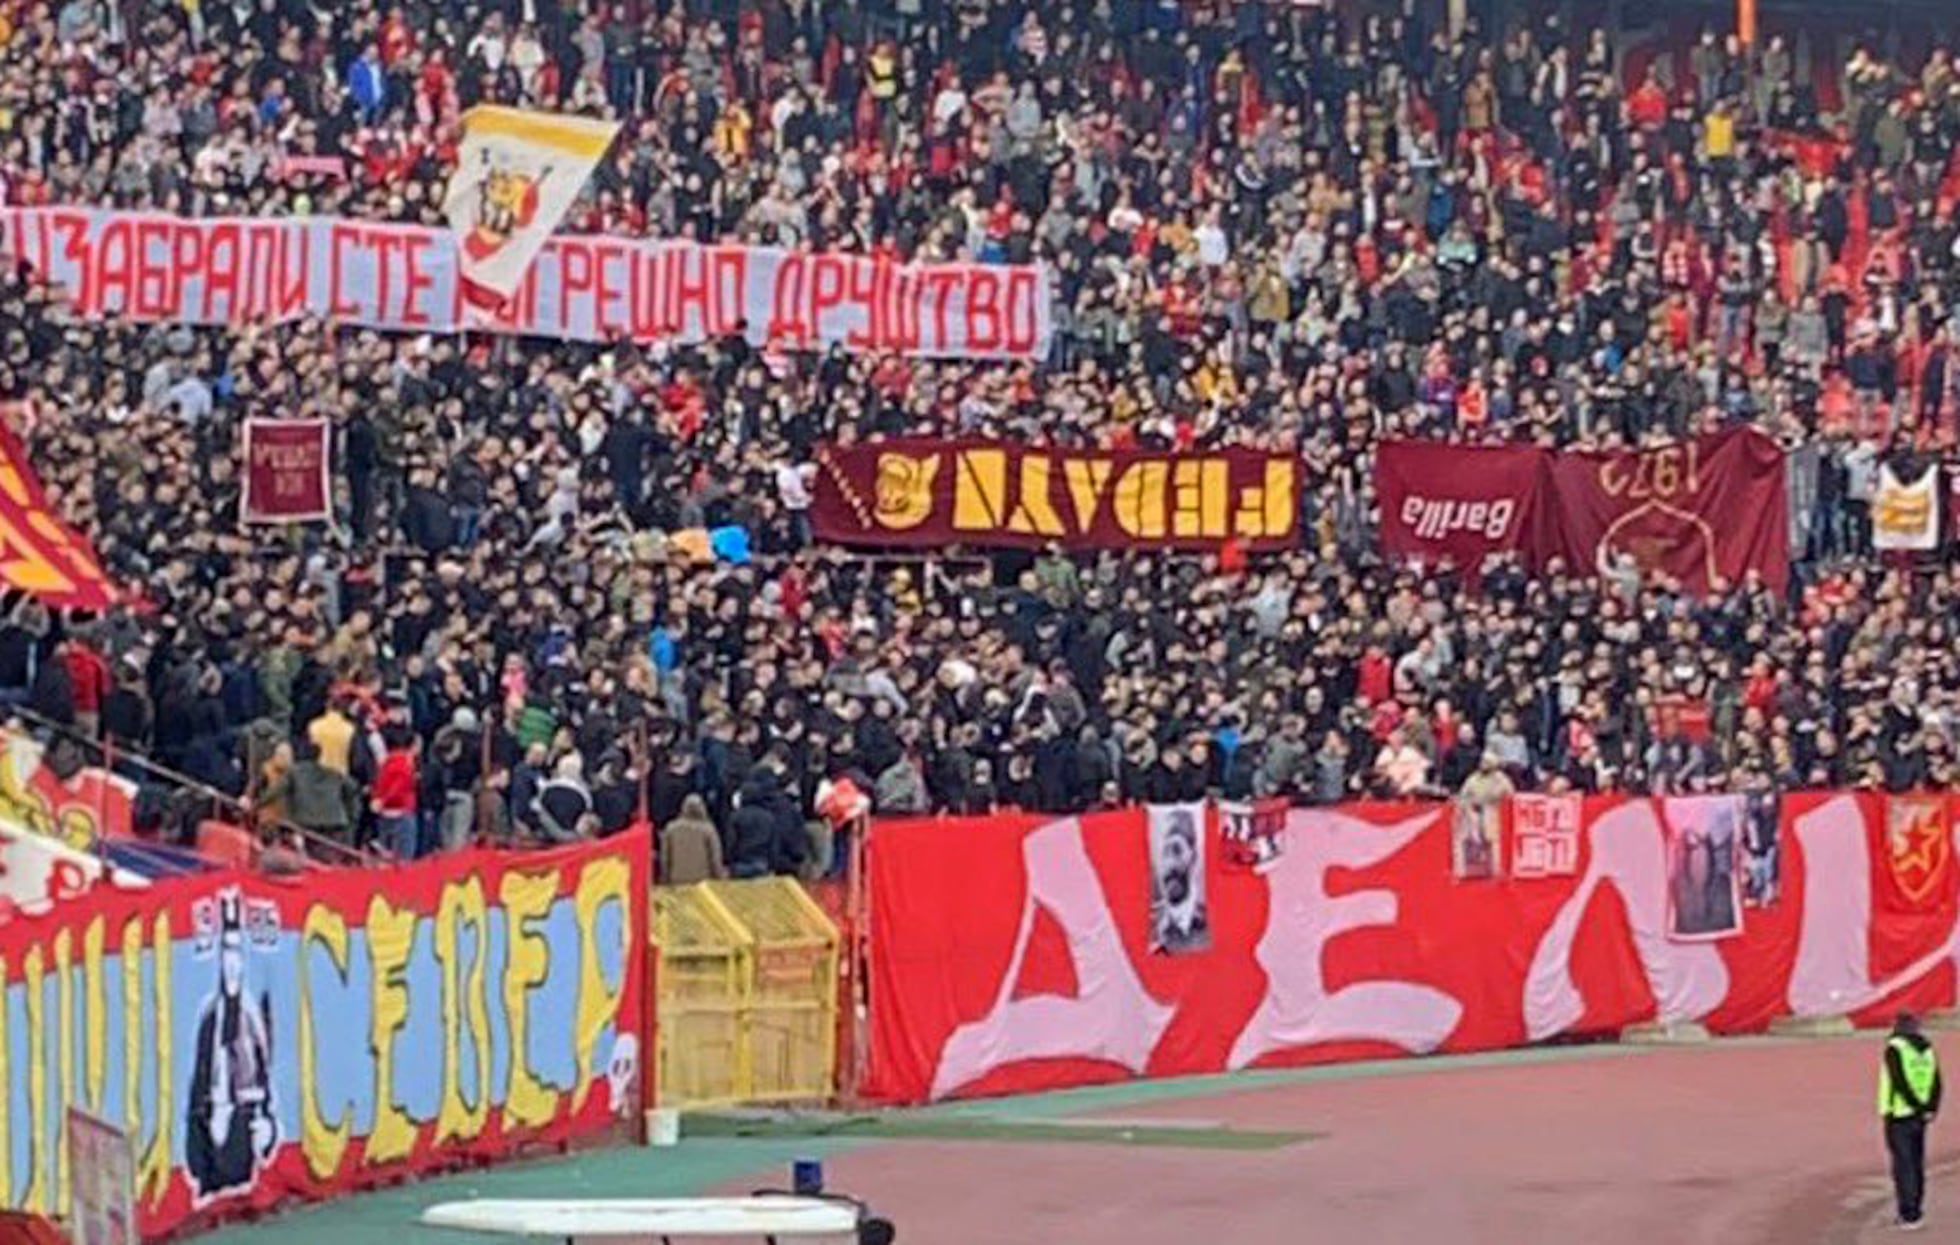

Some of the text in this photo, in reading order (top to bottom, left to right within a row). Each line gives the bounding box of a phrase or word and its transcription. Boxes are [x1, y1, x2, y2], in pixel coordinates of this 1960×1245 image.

[331, 225, 432, 323] СТЕ
[454, 241, 745, 332] ГРЕШНО
[766, 252, 1037, 352] ДРУШТВО
[952, 449, 1295, 538] FEDAYN
[1401, 495, 1514, 540] Barilla
[301, 857, 630, 1180] СЕВЕР
